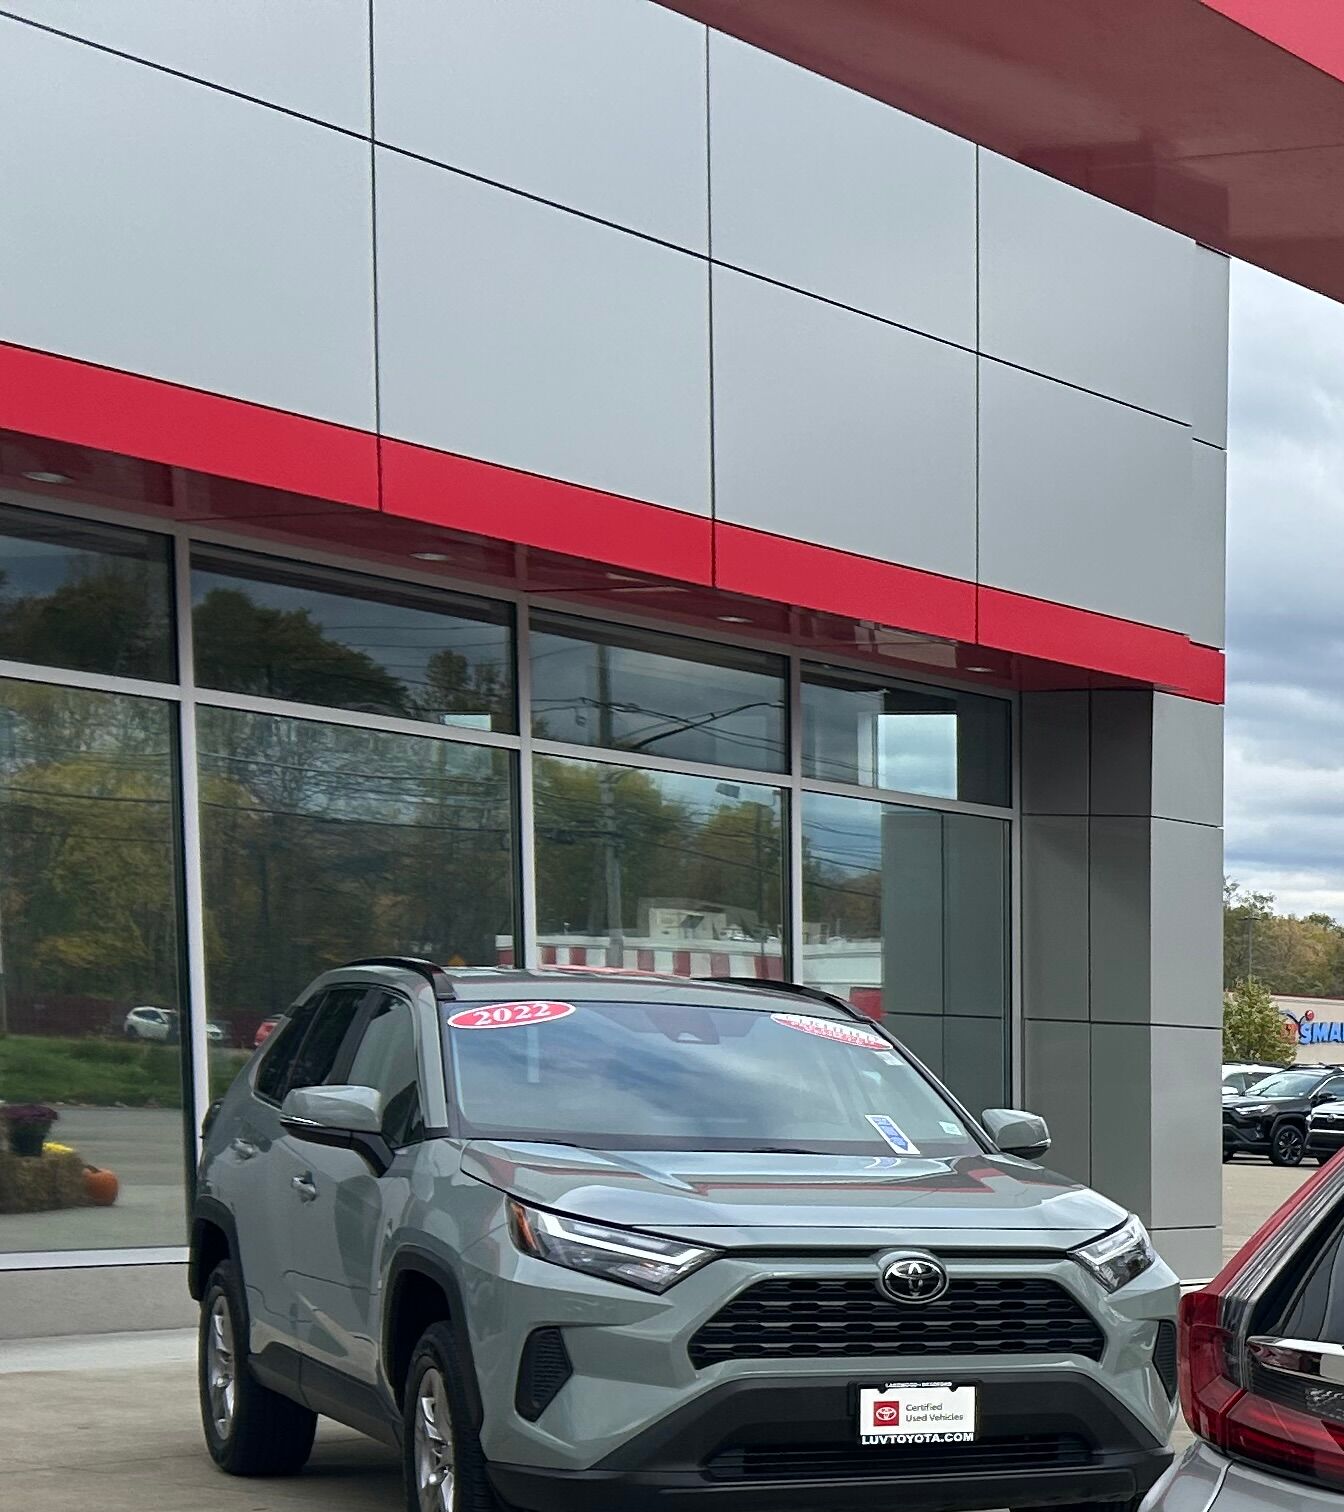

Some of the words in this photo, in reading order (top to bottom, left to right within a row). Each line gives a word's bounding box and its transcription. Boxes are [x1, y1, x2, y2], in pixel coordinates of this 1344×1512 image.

[473, 1003, 551, 1025] 2022
[905, 1403, 943, 1412] Certified
[905, 1414, 928, 1422] Used
[929, 1413, 964, 1421] Vehicles
[861, 1432, 974, 1445] LUVTOYOTA.COM
